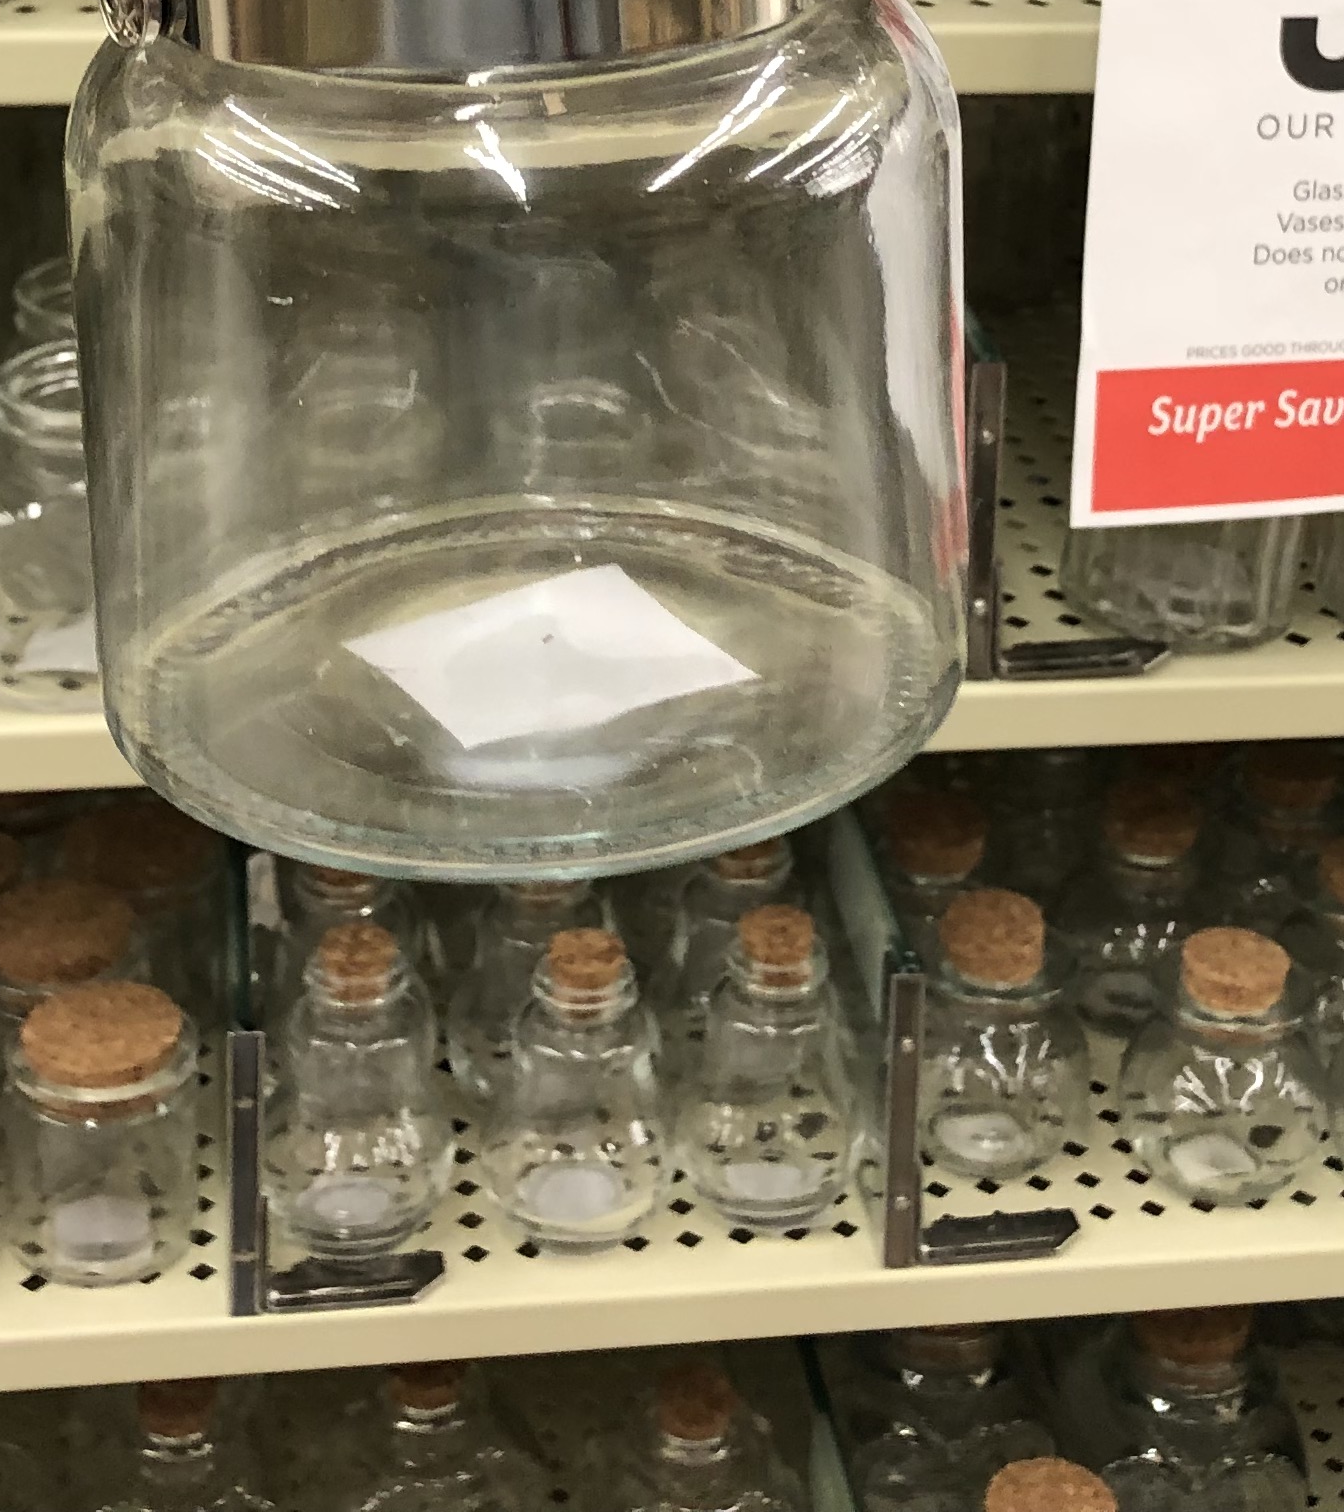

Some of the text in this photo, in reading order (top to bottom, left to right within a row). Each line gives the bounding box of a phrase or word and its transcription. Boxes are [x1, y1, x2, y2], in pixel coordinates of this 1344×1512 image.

[1256, 113, 1335, 141] OUR
[1276, 212, 1344, 234] Vases
[1253, 243, 1314, 266] Does
[1185, 343, 1238, 361] PRICES
[1241, 341, 1286, 358] GOOD
[1146, 394, 1267, 445] Super
